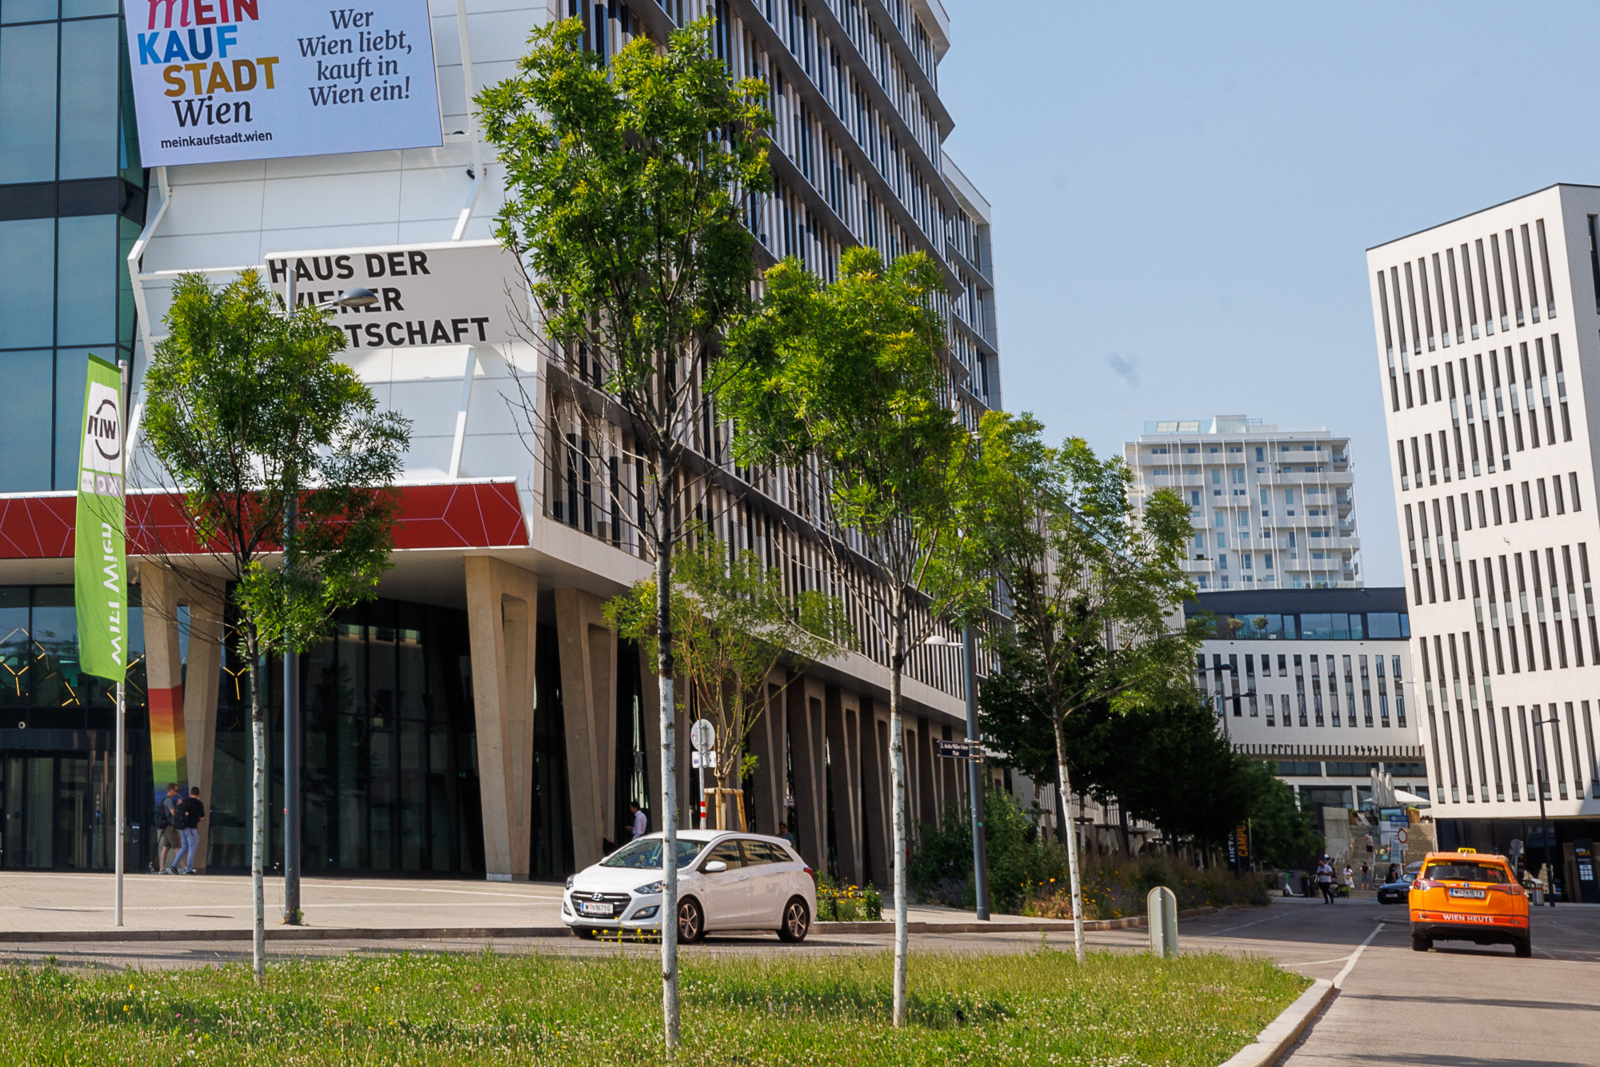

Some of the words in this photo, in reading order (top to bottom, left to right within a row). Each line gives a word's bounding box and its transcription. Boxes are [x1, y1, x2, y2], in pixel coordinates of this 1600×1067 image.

[329, 8, 374, 30] Wer
[137, 25, 238, 65] KAUF
[297, 35, 352, 58] Wien
[358, 29, 413, 55] liebt,
[162, 56, 280, 97] STADT
[316, 57, 372, 84] kauft
[377, 55, 399, 76] in
[308, 84, 364, 107] Wien
[369, 76, 410, 101] ein!
[172, 95, 253, 128] Wien
[160, 130, 273, 149] meinkaufstadt.wien
[268, 255, 355, 283] HAUS
[365, 250, 431, 279] DER
[328, 317, 490, 349] TSCHAFT
[1442, 914, 1465, 922] WIEN
[1467, 915, 1494, 923] HEUTE
